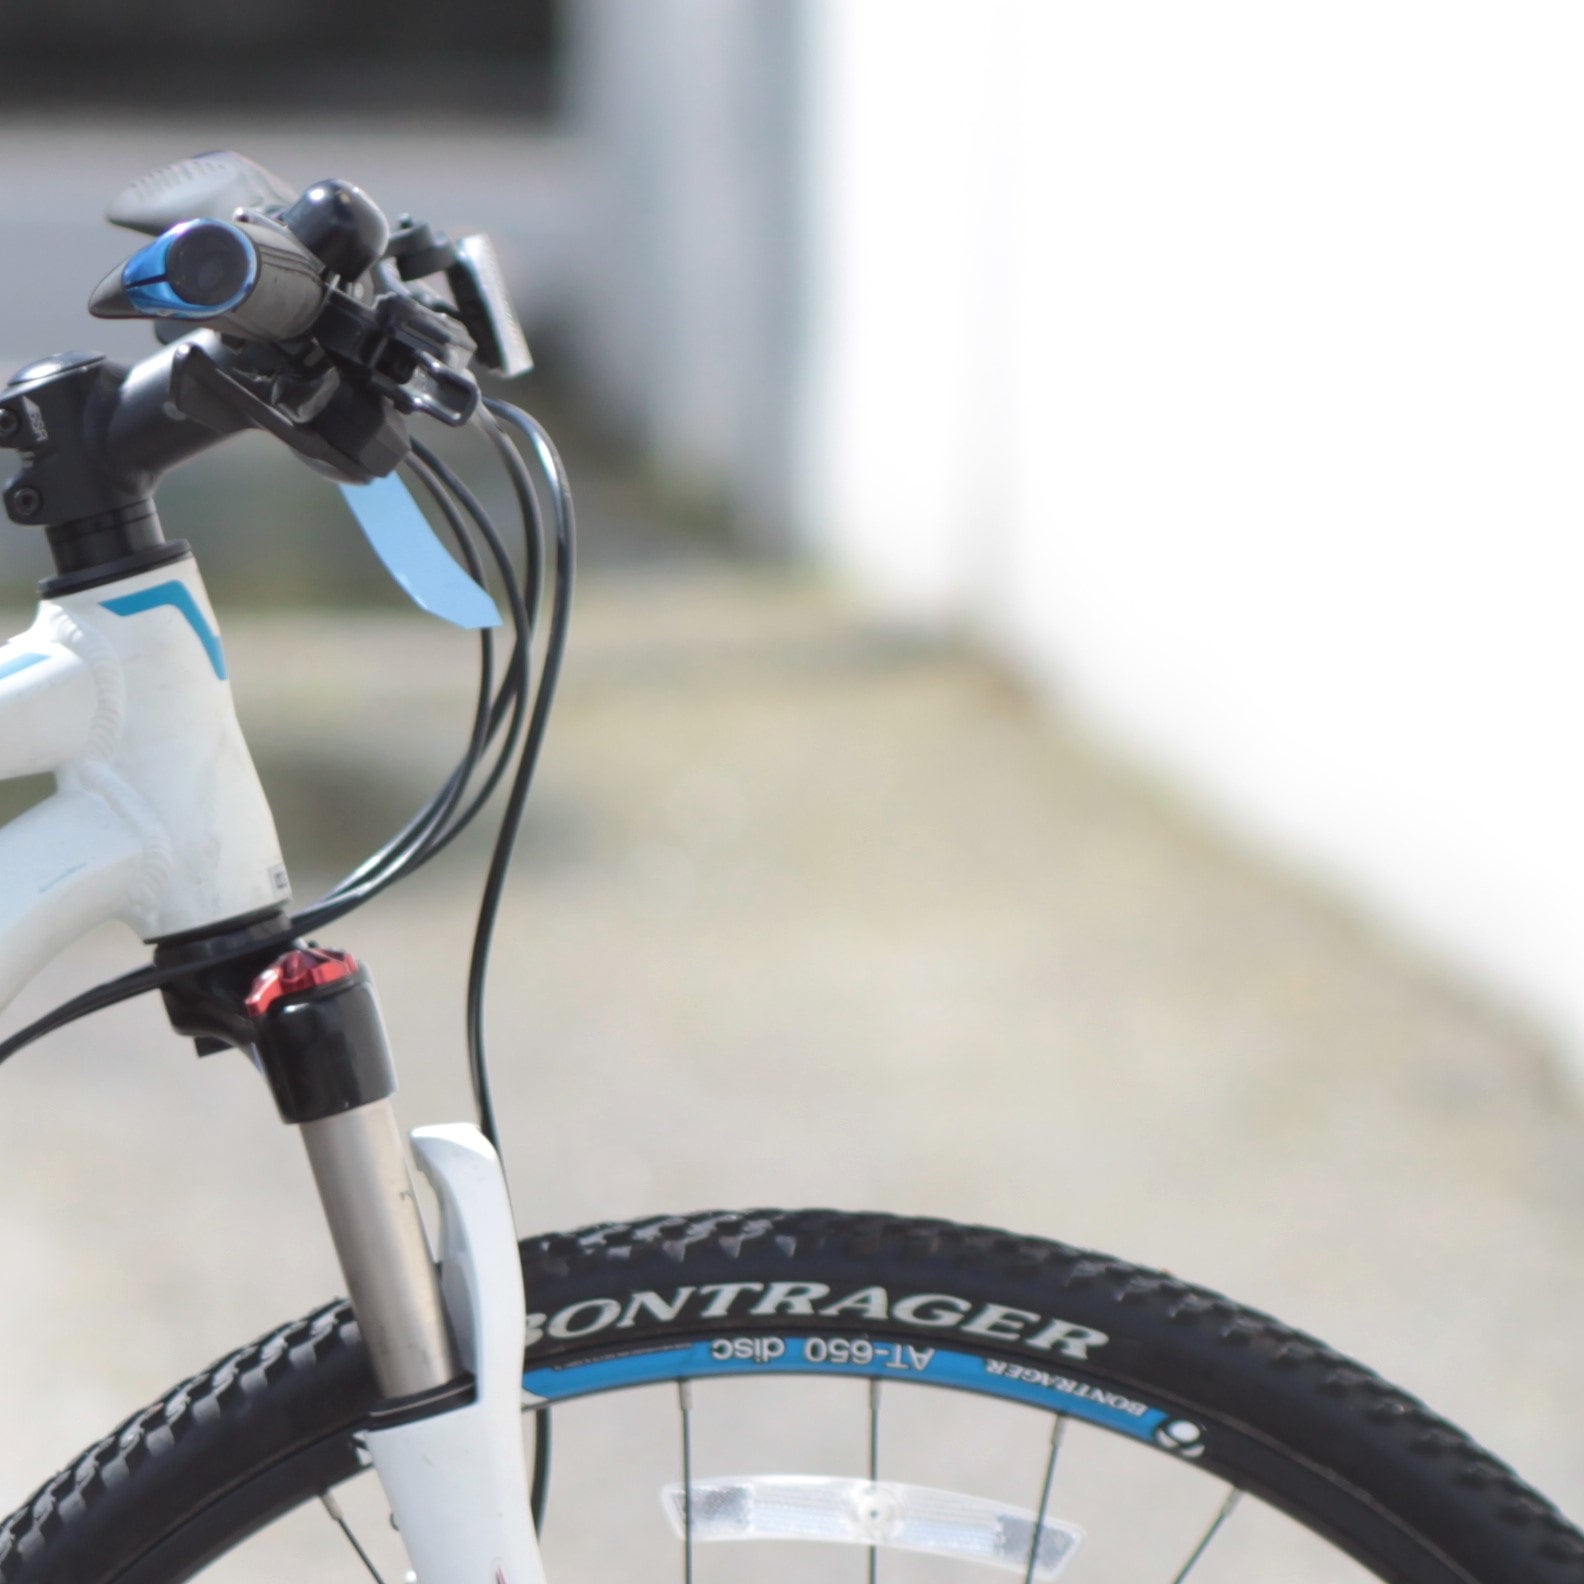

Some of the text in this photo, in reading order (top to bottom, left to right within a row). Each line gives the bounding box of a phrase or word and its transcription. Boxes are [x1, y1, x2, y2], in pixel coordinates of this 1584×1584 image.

[711, 1335, 786, 1363] disc
[804, 1336, 936, 1371] AT-650
[985, 1357, 1149, 1417] BONTRAGER
